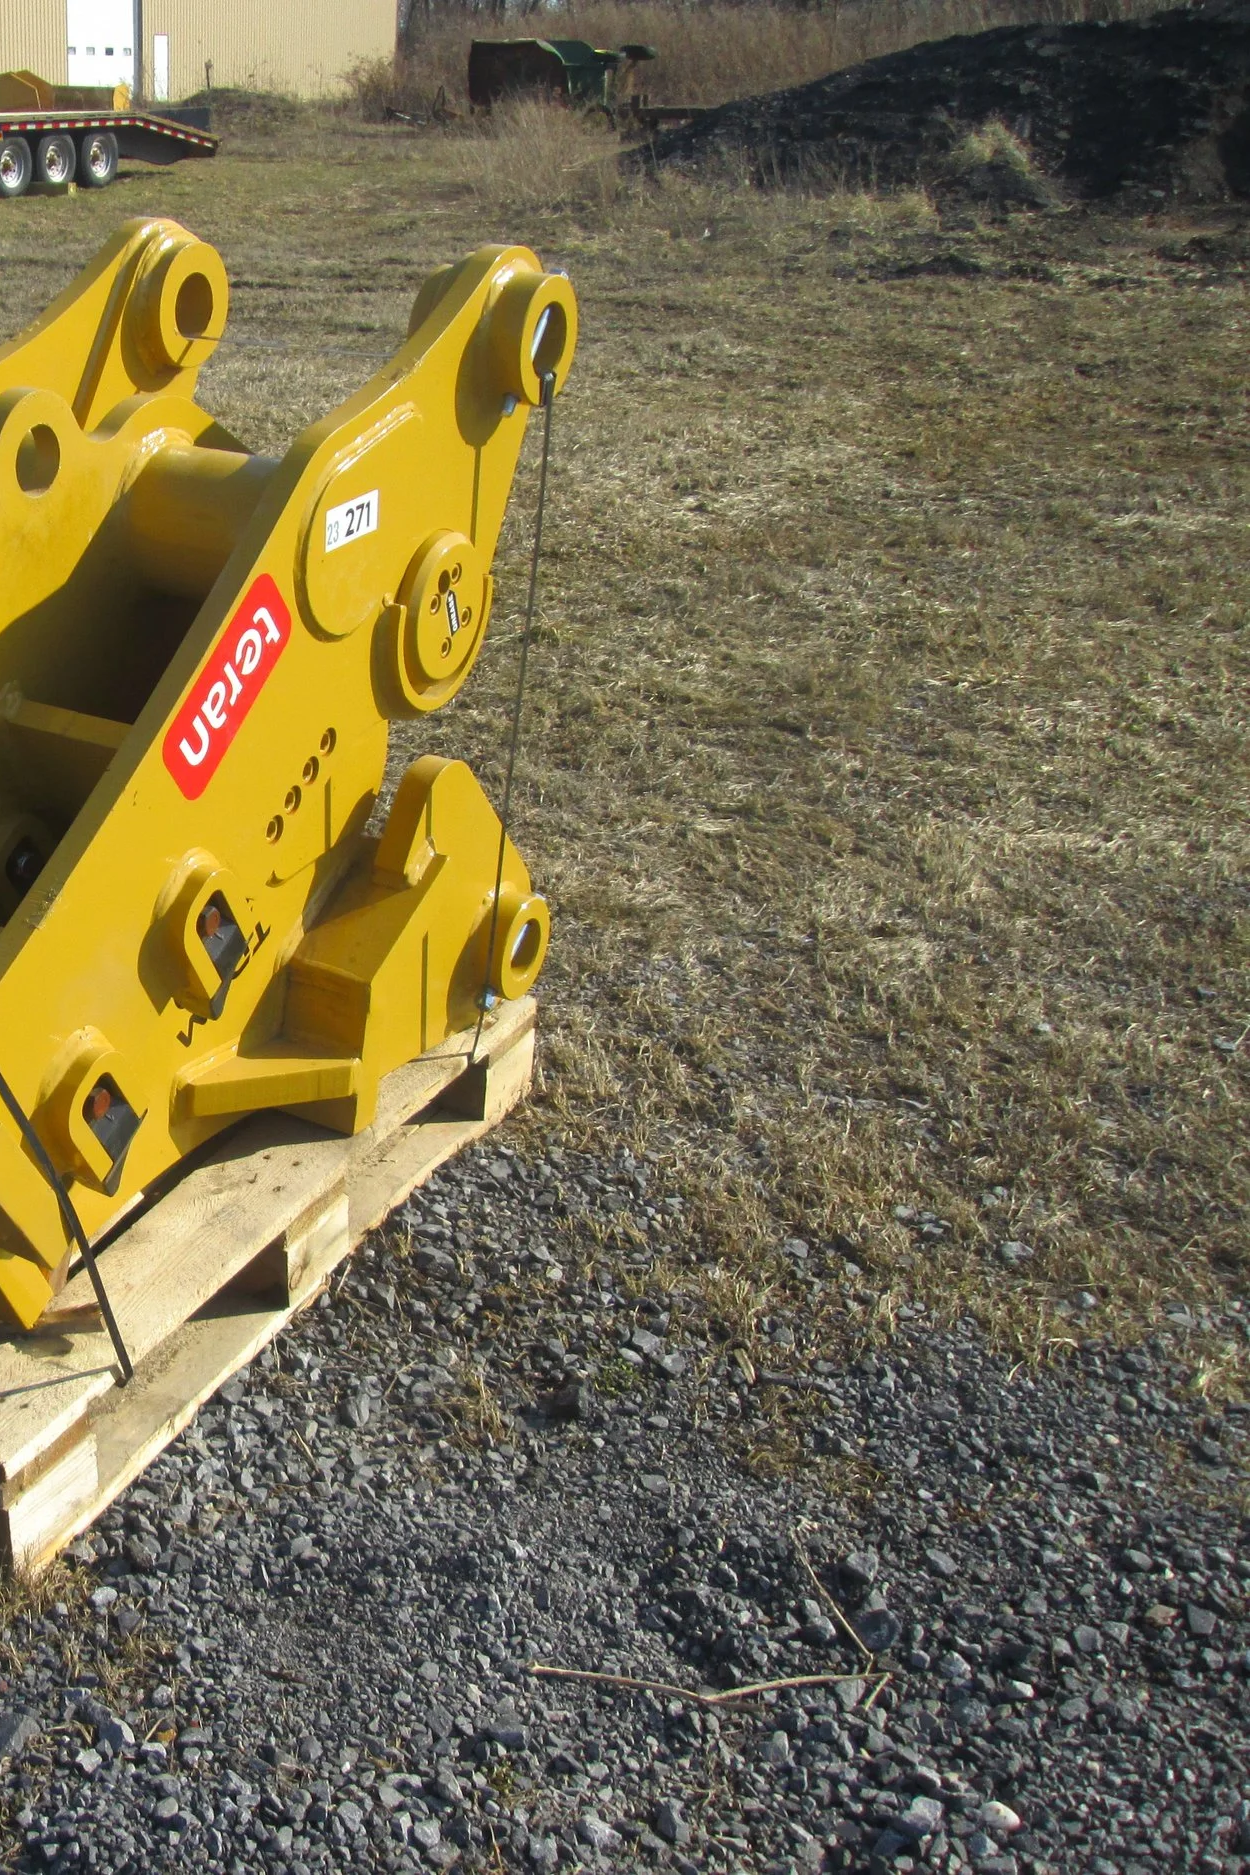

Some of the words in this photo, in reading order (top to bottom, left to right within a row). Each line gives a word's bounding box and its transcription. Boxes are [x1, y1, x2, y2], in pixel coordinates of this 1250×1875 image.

[327, 520, 339, 545] 23
[345, 500, 371, 537] 271
[448, 593, 458, 632] GREASE
[179, 606, 281, 767] teran
